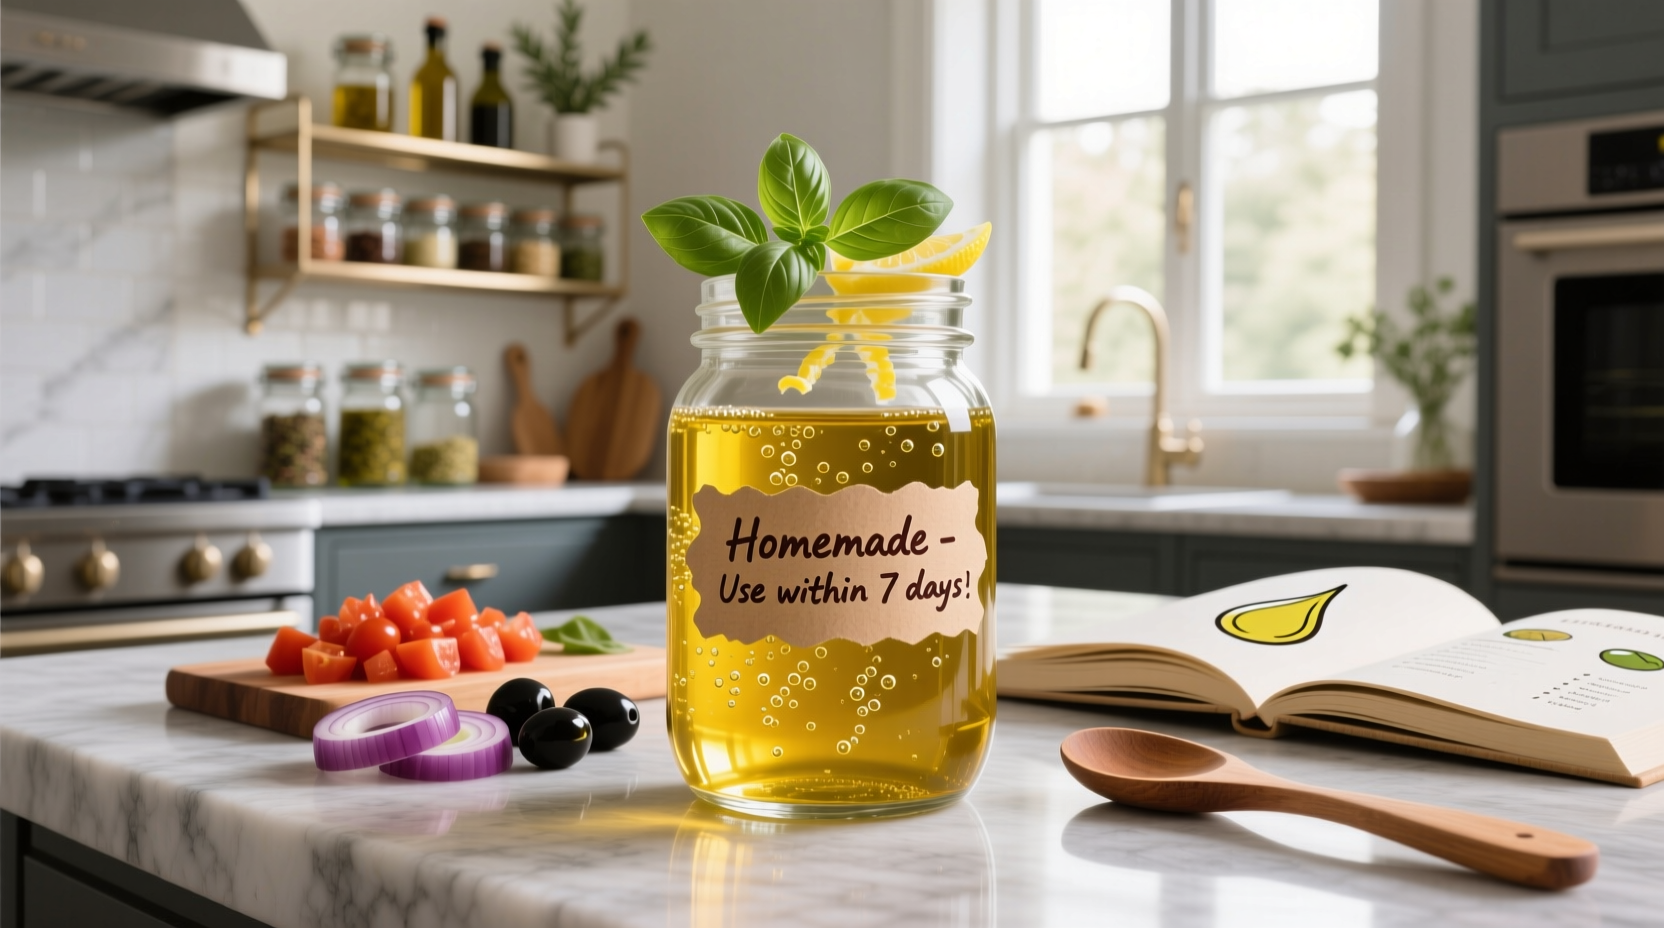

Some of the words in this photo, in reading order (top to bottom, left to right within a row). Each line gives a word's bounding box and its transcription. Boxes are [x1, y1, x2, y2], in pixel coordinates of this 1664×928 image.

[726, 514, 929, 563] Homemade
[719, 573, 767, 604] Use
[777, 571, 869, 605] within
[879, 572, 900, 604] 7
[905, 568, 971, 612] days!
